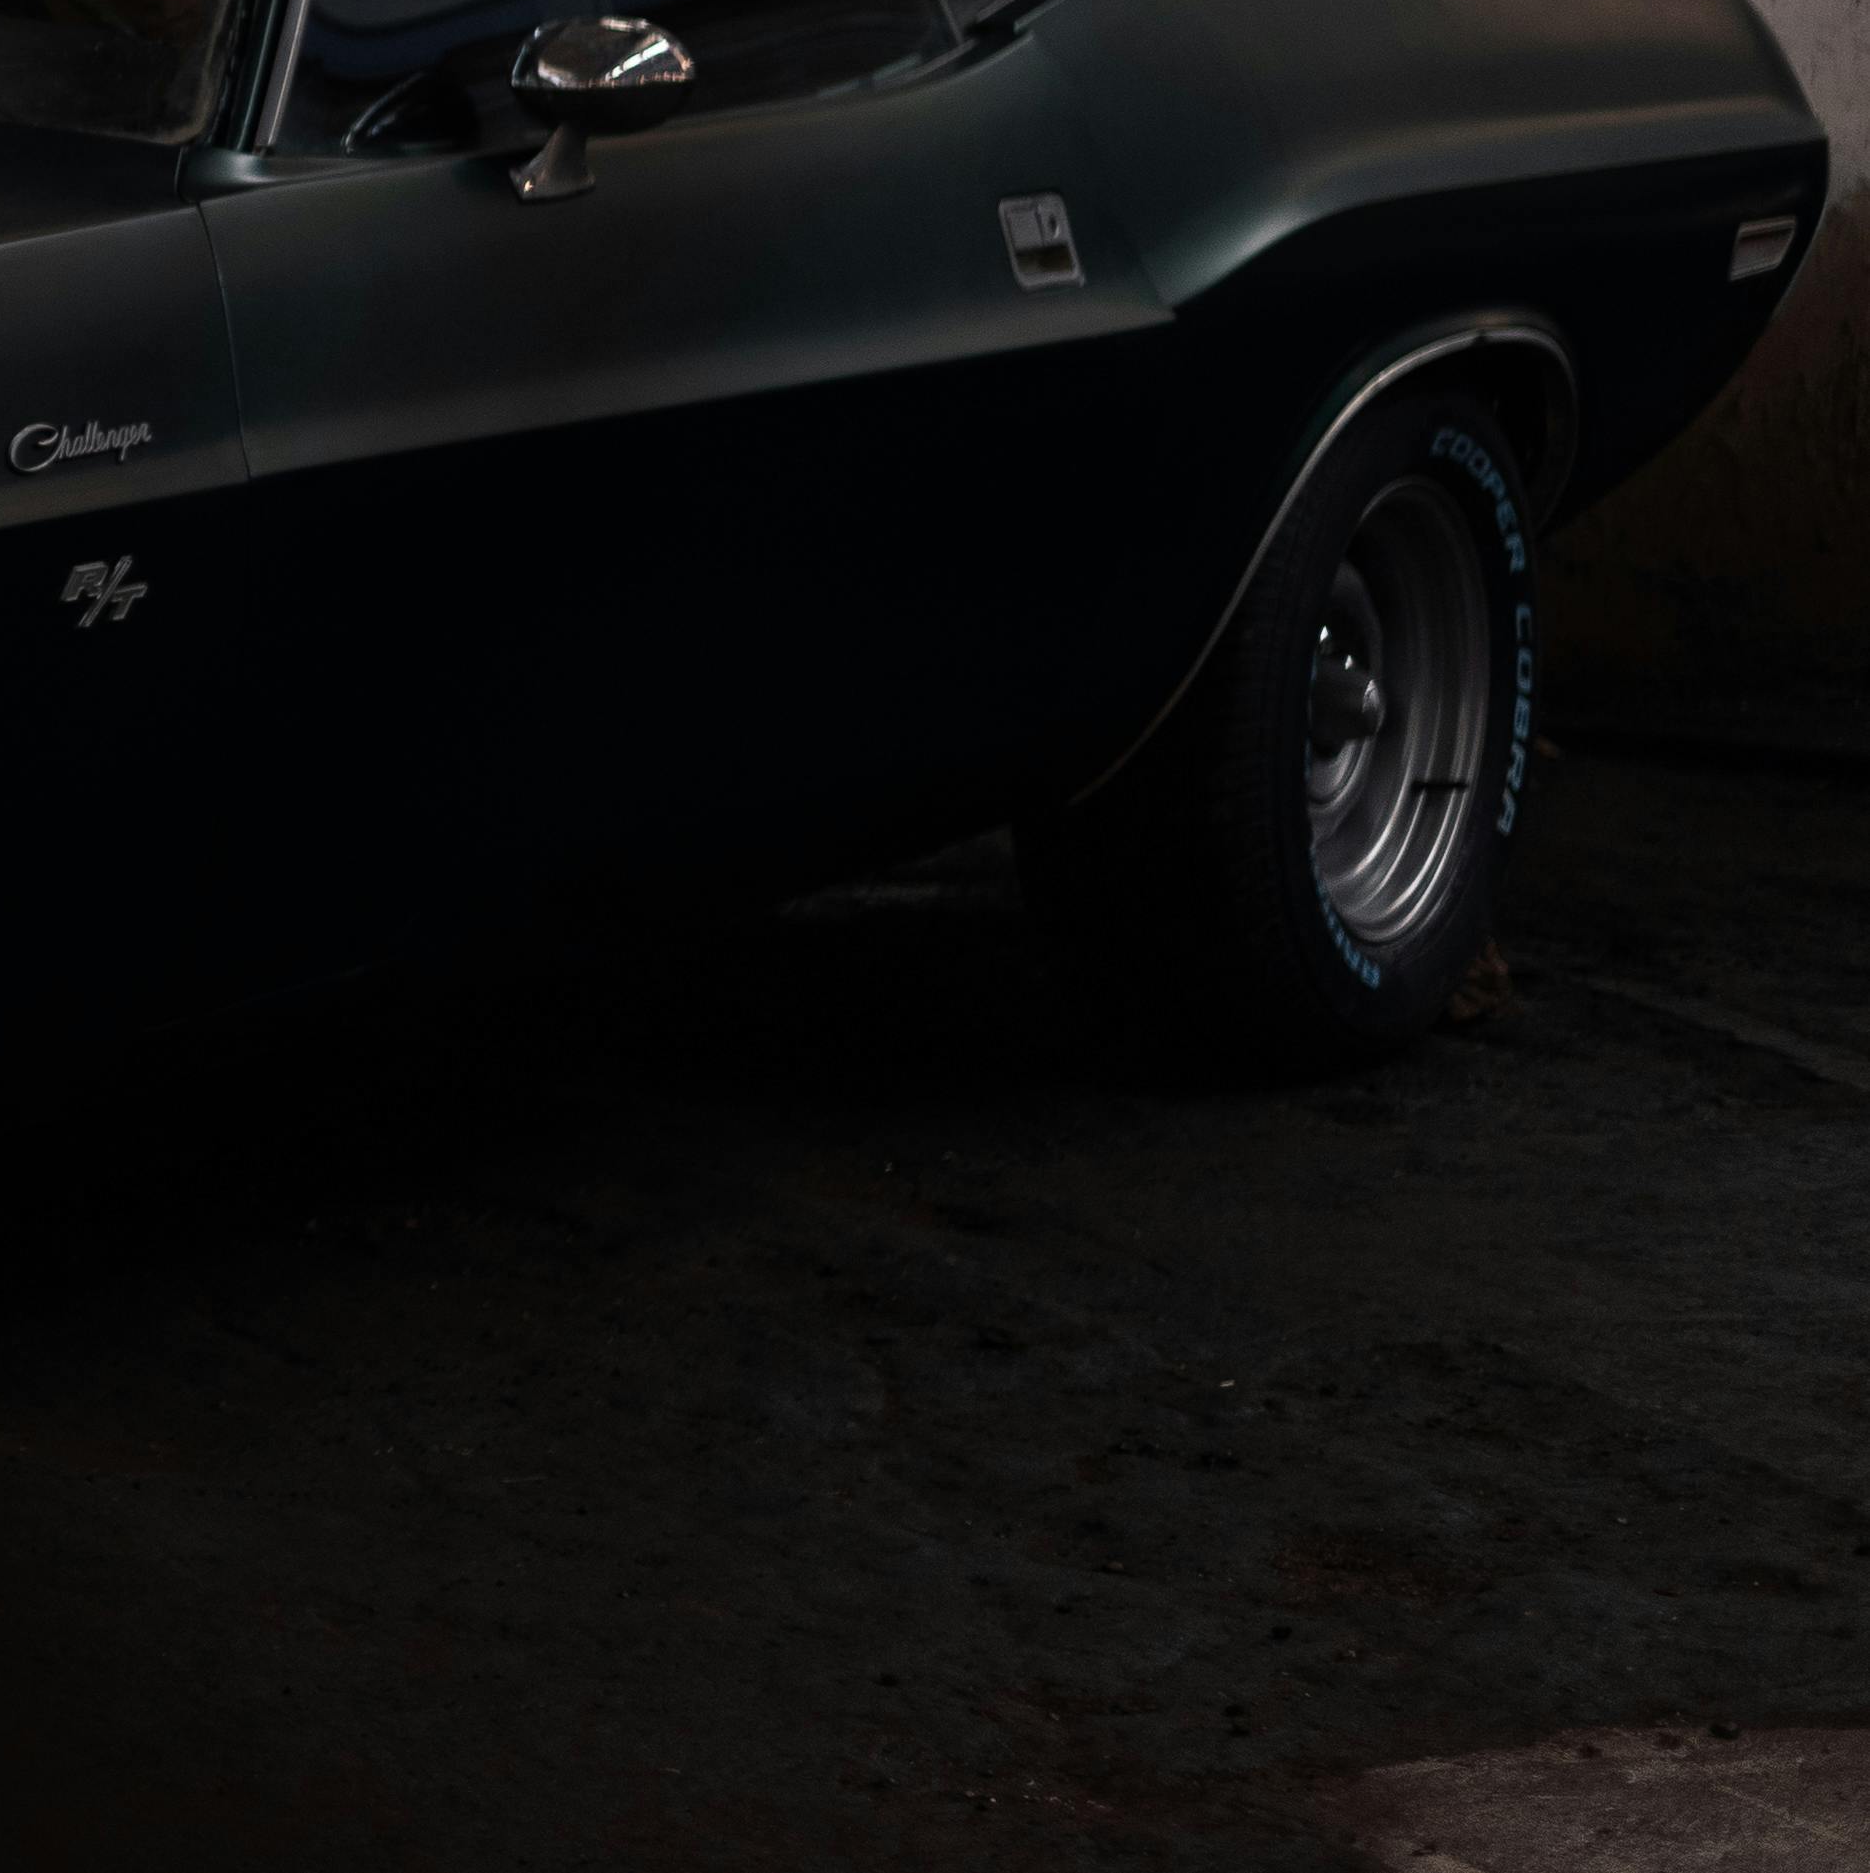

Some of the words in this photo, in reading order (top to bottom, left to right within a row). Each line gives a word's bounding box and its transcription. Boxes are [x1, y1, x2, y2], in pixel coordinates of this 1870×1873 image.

[9, 420, 153, 473] Challenger
[60, 554, 148, 629] R/T
[1428, 424, 1527, 574] COOPER
[1496, 601, 1534, 838] COBRA
